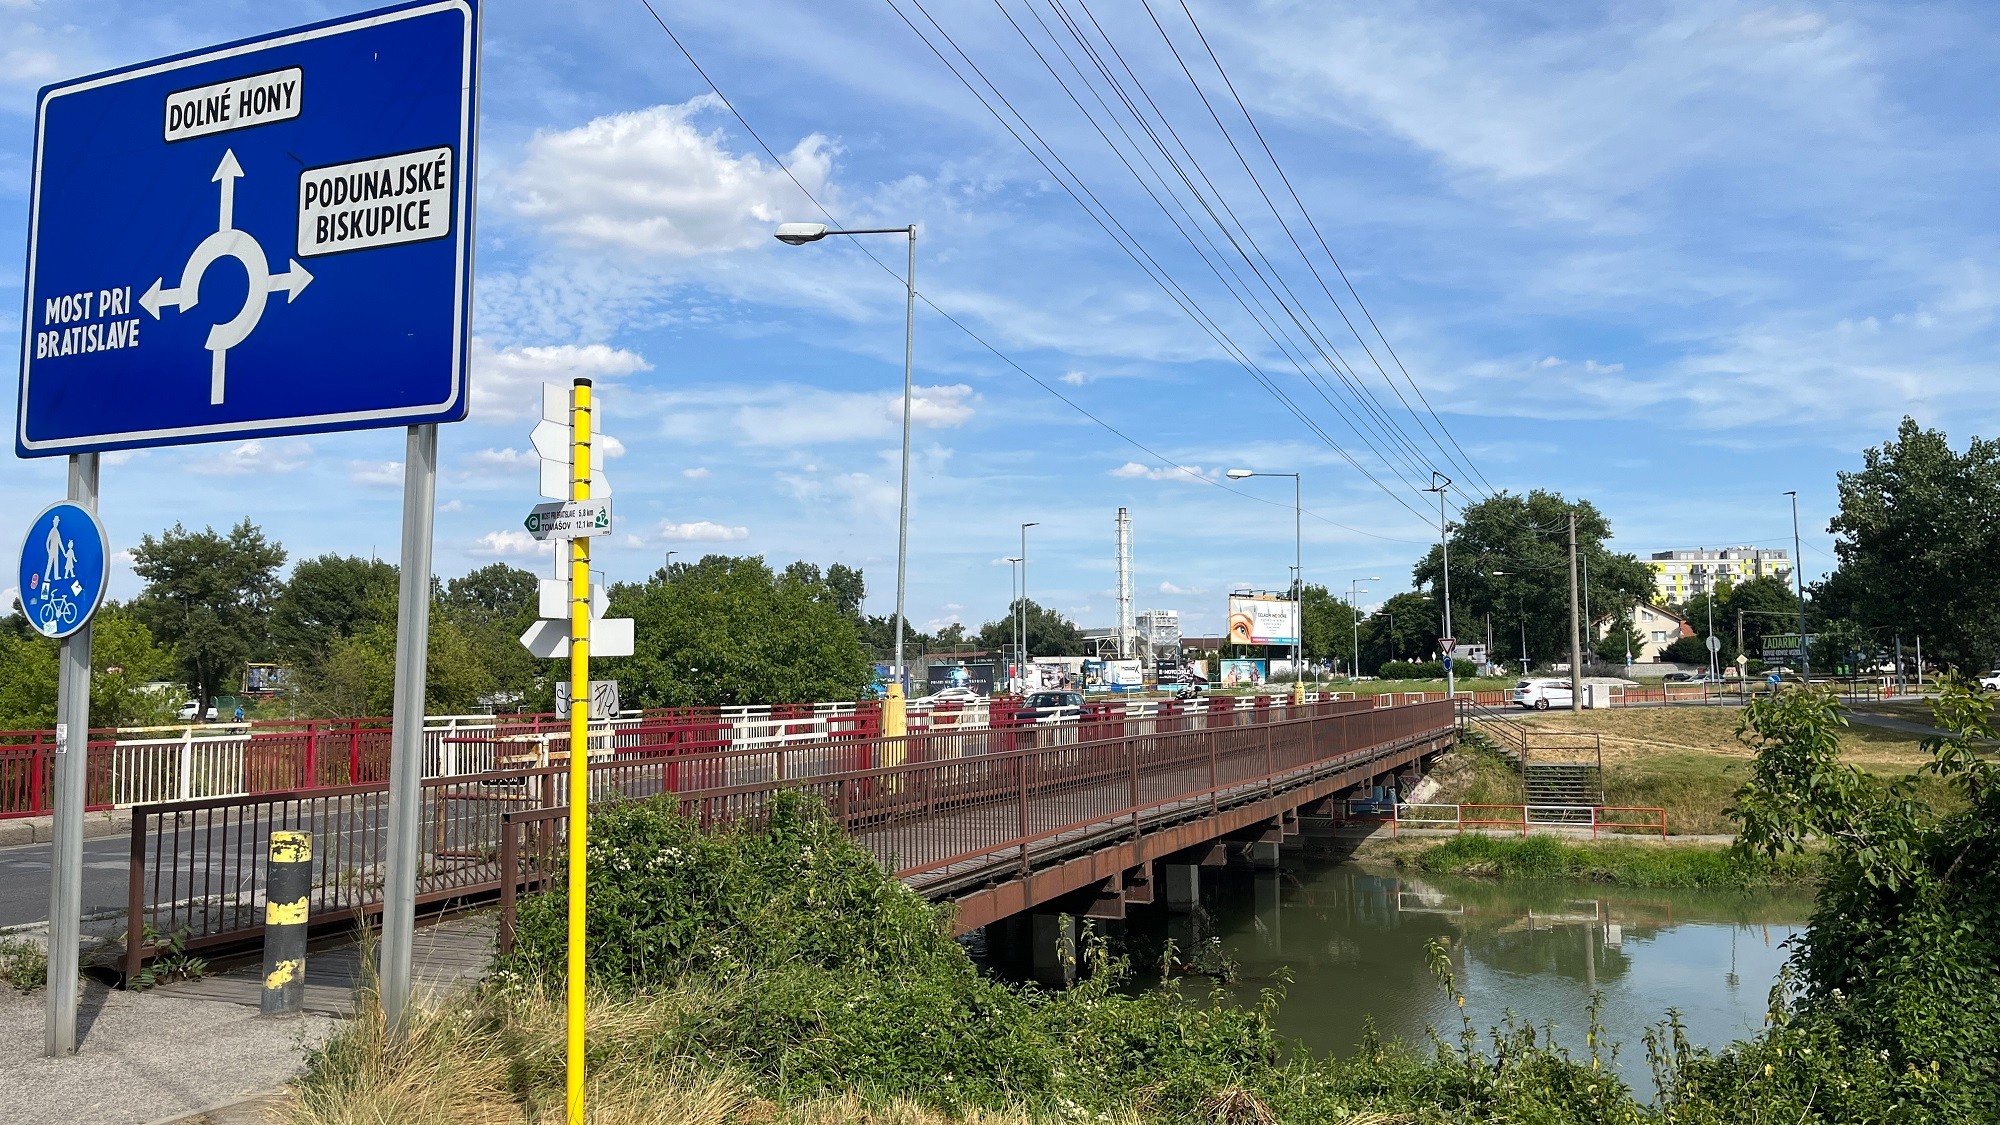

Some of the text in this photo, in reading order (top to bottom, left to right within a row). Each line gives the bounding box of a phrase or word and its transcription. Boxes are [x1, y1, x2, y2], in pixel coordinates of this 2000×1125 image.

[170, 80, 296, 132] DOLNÉ HONY
[304, 153, 446, 211] PODUNAJSKÉ
[316, 199, 430, 245] BISKUPICE
[45, 286, 131, 326] MOST PRI
[36, 319, 140, 360] BRATISLAVE
[576, 520, 586, 529] 12,1
[578, 508, 586, 518] 5,8
[587, 509, 594, 517] km
[1763, 637, 1800, 649] ZADARMO
